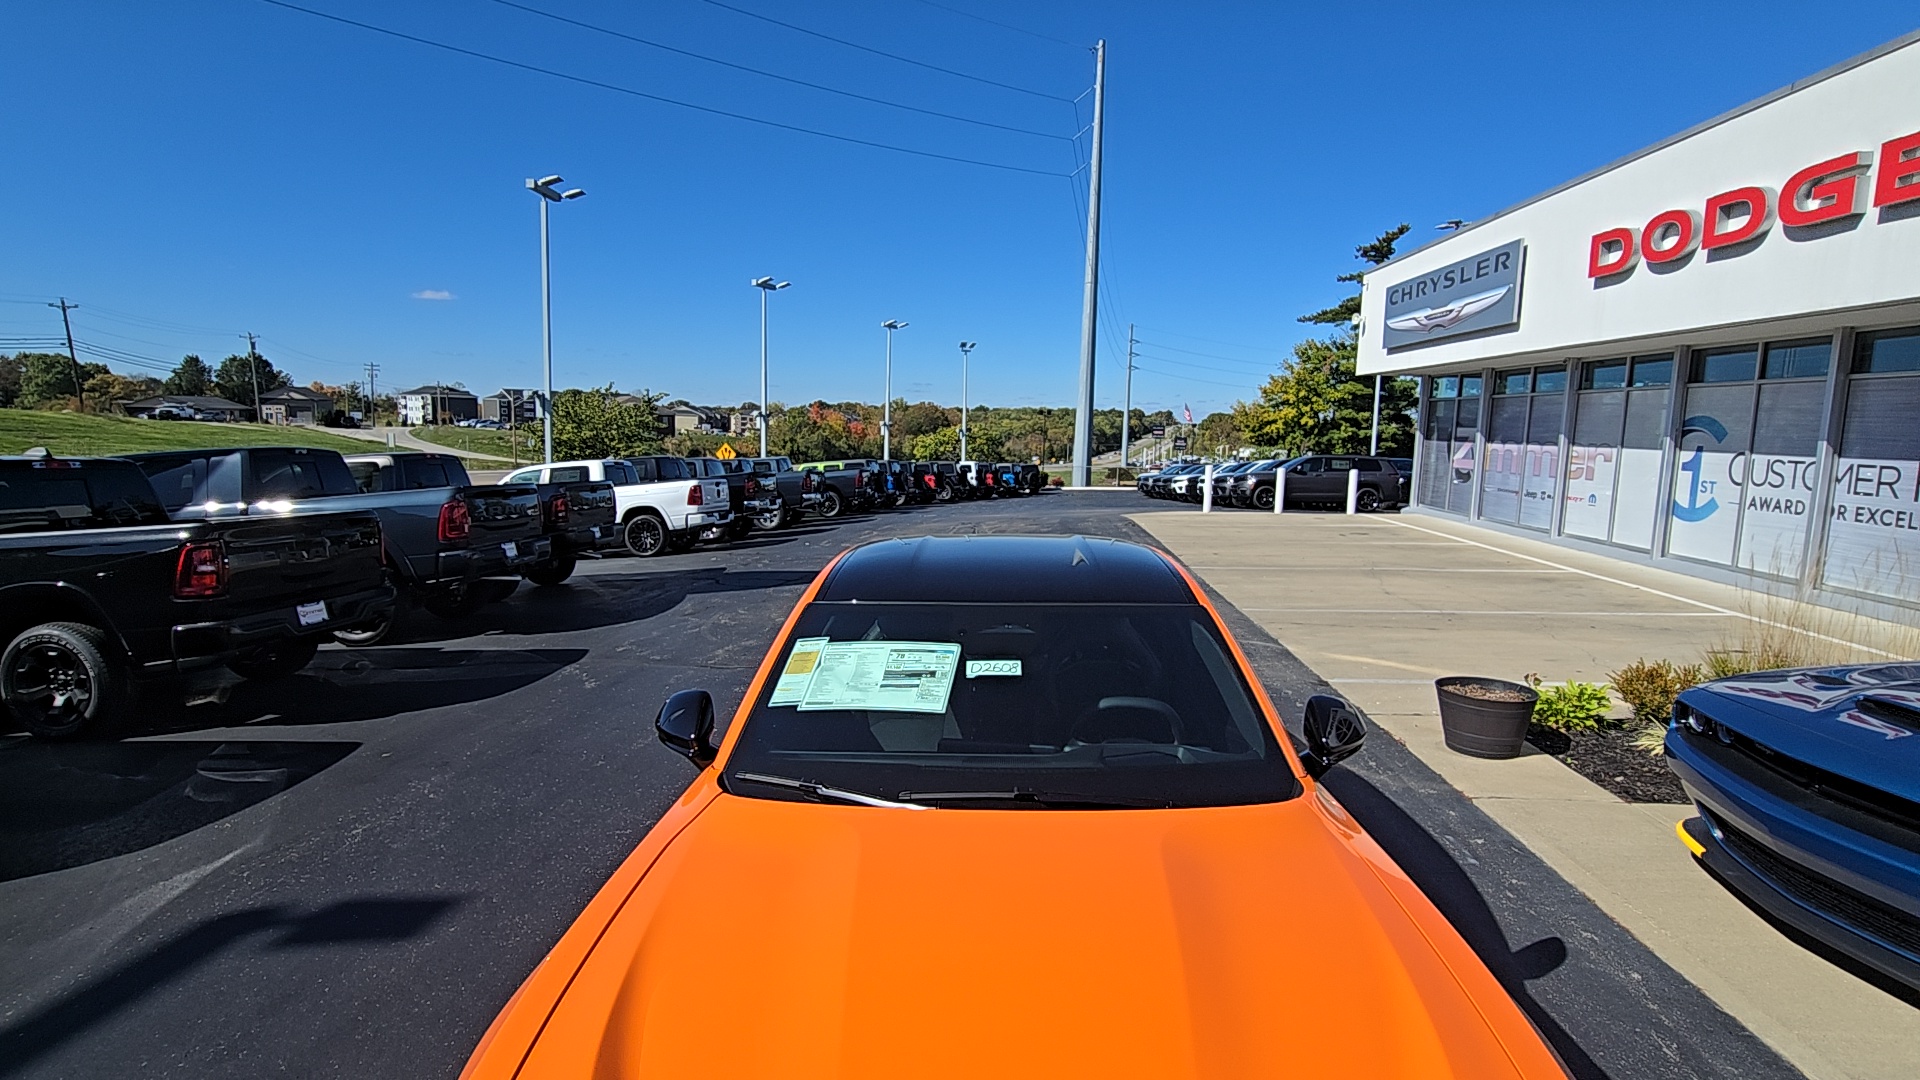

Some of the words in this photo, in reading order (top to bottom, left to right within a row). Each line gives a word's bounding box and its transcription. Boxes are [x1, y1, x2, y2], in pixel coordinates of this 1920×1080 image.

[1588, 131, 1920, 278] DODGE
[1389, 251, 1511, 306] CHRYSLER
[1452, 440, 1613, 481] Zmmer
[1524, 489, 1537, 499] Jeep
[488, 503, 528, 516] RAM
[1747, 496, 1806, 516] AWARD
[971, 663, 1019, 673] D2608
